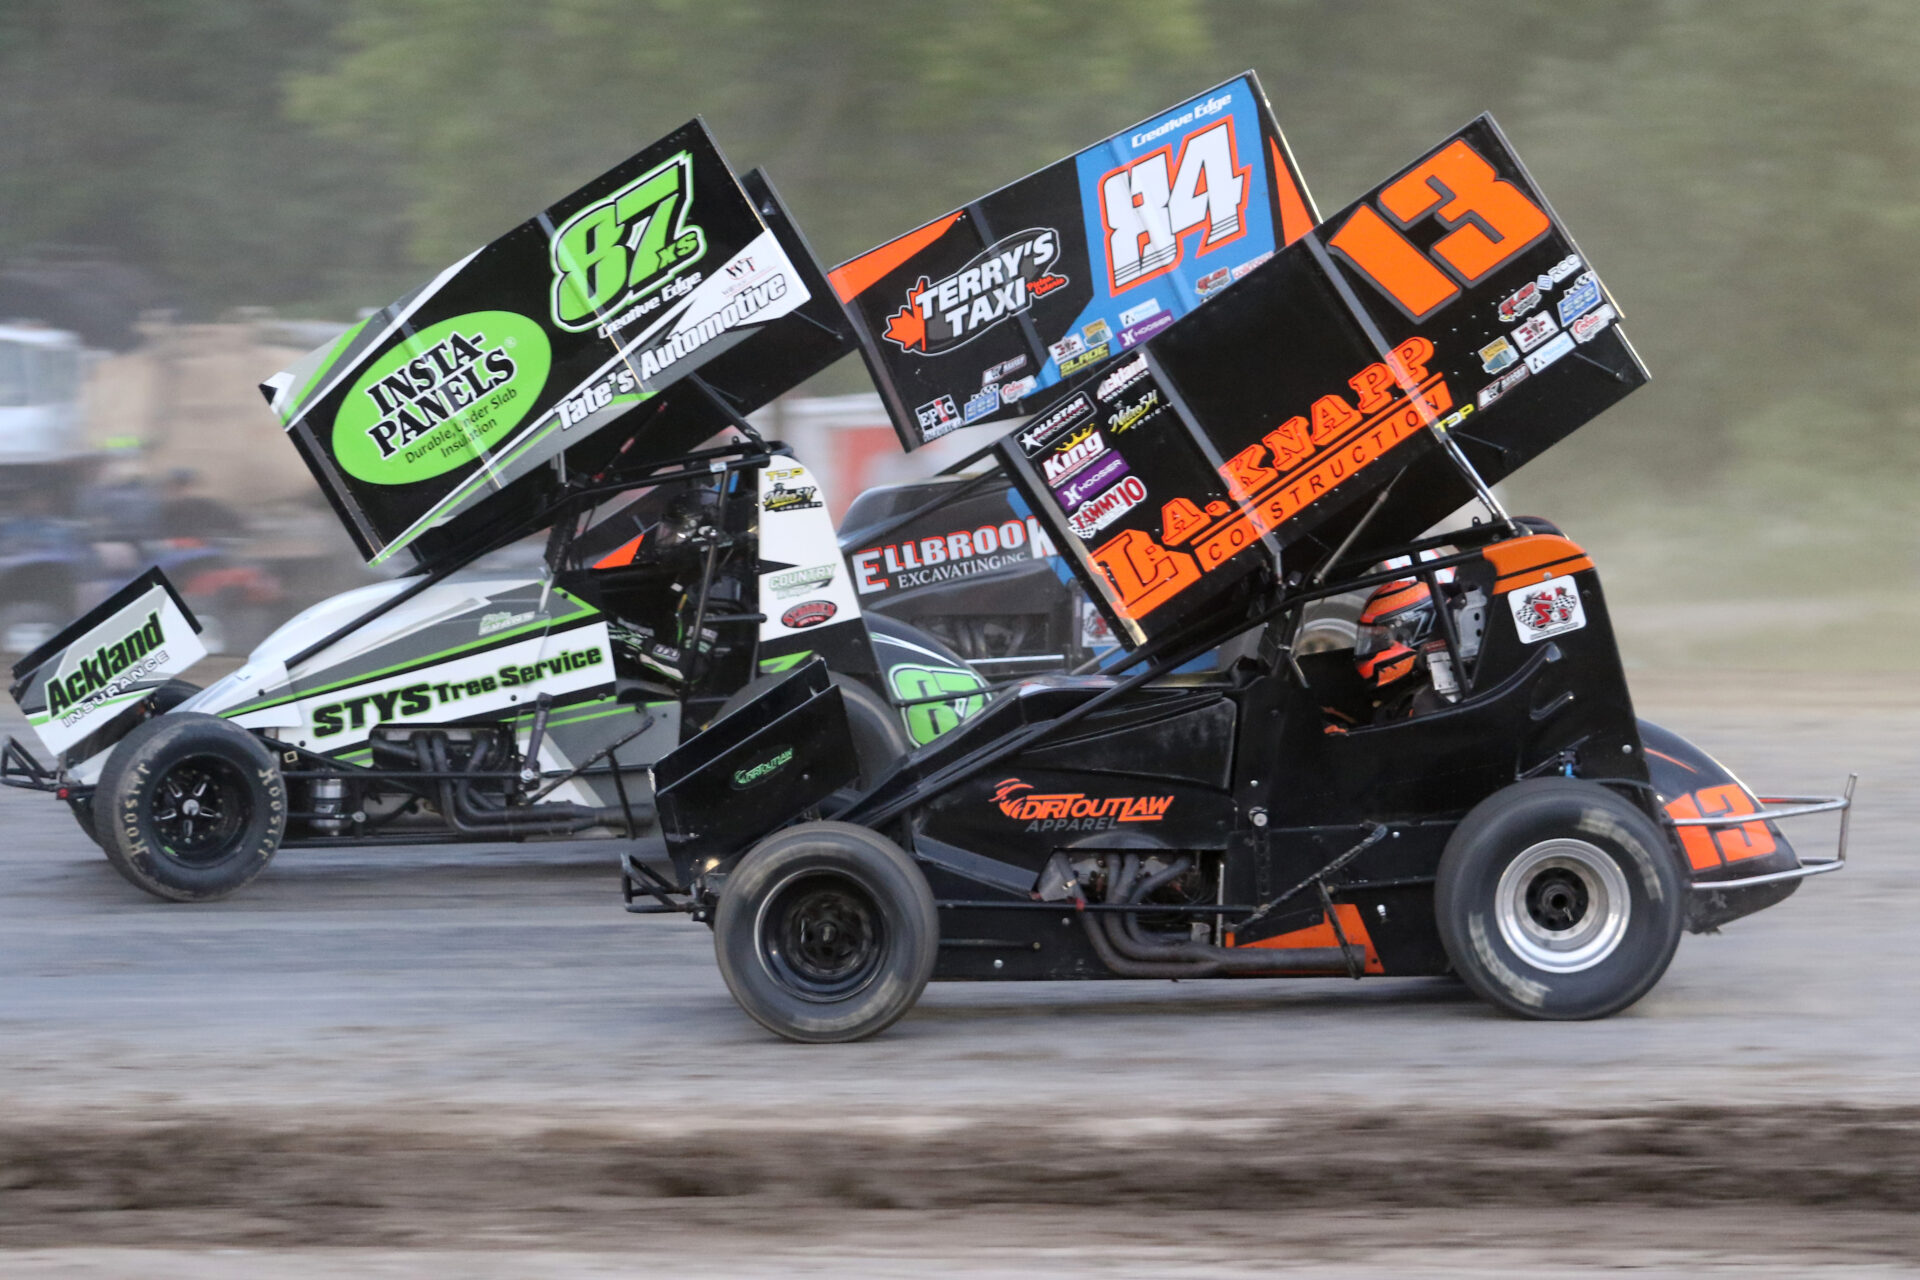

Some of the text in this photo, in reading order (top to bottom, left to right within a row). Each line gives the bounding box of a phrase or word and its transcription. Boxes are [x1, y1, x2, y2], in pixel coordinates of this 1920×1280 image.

[1132, 94, 1232, 149] Creative Edge
[1099, 115, 1251, 297] 84
[1328, 138, 1551, 323] 13
[661, 271, 703, 302] Edge
[915, 231, 1056, 319] TERRY'S
[945, 276, 1027, 338] TAXI
[1134, 314, 1172, 336] HOOSIER
[366, 331, 487, 418] INSTA-
[553, 366, 636, 431] Tate's
[639, 273, 788, 381] Automotive
[366, 346, 517, 459] PANELS
[918, 399, 956, 431] EPIC
[1033, 397, 1085, 436] ALLSTAR
[1103, 369, 1150, 404] INSURANCE
[405, 386, 518, 464] Durable, Under Slab
[440, 418, 498, 458] Insulation
[1219, 336, 1435, 500] KNAPP
[1041, 429, 1106, 482] King
[1078, 458, 1123, 492] HOOSIER
[1208, 395, 1441, 562] CONSTRUCTION
[1073, 490, 1120, 529] TAMMY
[1117, 478, 1144, 508] 10
[769, 563, 836, 591] COUNTRY
[897, 551, 1029, 589] EXCAVATING INC.
[45, 609, 166, 720] Ackland
[62, 650, 171, 728] INSURANCE
[312, 682, 431, 739] STYS
[431, 675, 497, 704] Tree
[499, 647, 604, 689] Service
[1024, 817, 1119, 833] APPAREL
[1664, 783, 1777, 871] 13
